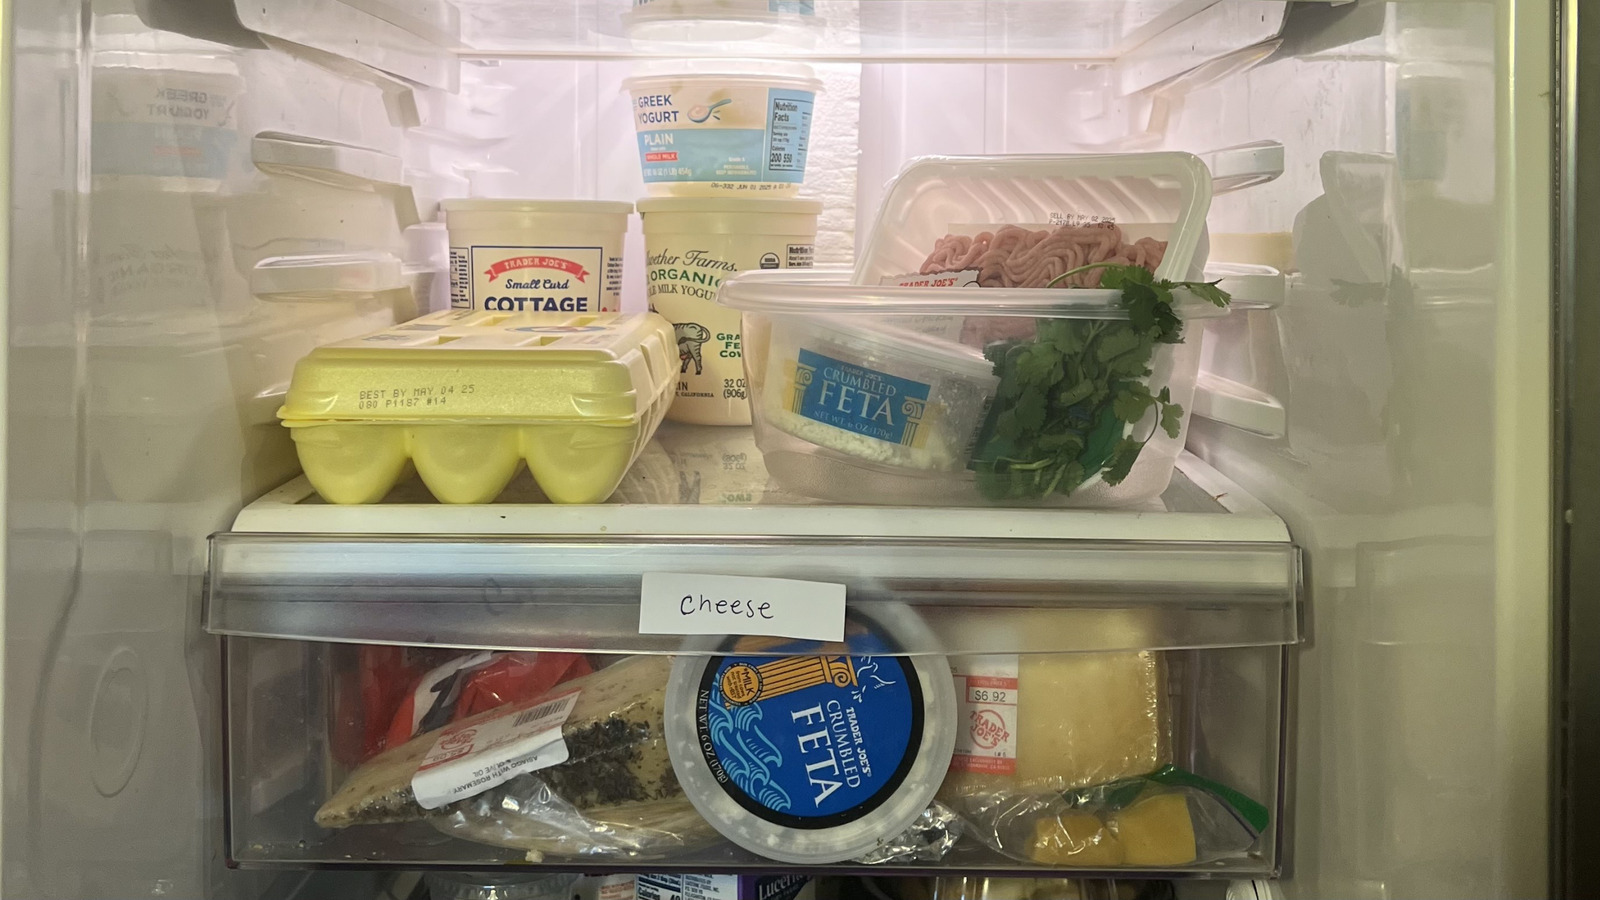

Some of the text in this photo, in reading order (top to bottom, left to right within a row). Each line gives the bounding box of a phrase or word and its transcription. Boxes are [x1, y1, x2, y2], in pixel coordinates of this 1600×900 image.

[638, 95, 672, 108] GREEK
[775, 102, 798, 111] Nutrition
[638, 111, 679, 124] YOGURT
[774, 112, 790, 122] Facts
[644, 133, 674, 146] PLAIN
[771, 153, 793, 163] 200 550
[504, 257, 568, 270] TRADER JOE'S
[505, 278, 570, 290] Small Curd
[658, 284, 678, 294] MILK
[681, 285, 716, 301] YOGU
[484, 296, 588, 312] COTTAGE
[716, 332, 741, 341] GRA
[725, 341, 741, 350] FE
[724, 379, 734, 388] 32
[823, 367, 897, 397] CRUMBLED
[359, 384, 475, 400] BEST BY MAY 04 25
[818, 379, 895, 427] FETA
[699, 690, 709, 710] NET
[975, 690, 1006, 703] $6.92
[845, 707, 863, 746] TRADER
[969, 710, 1010, 742] TRADER
[970, 724, 1001, 747] JOE'S
[703, 742, 715, 759] OZ
[826, 700, 861, 788] CRUMBLED
[790, 702, 844, 809] FETA
[453, 755, 538, 794] ASIAGO WITH ROSEMARY
[472, 769, 484, 778] OIL
[709, 759, 729, 784] (170g)
